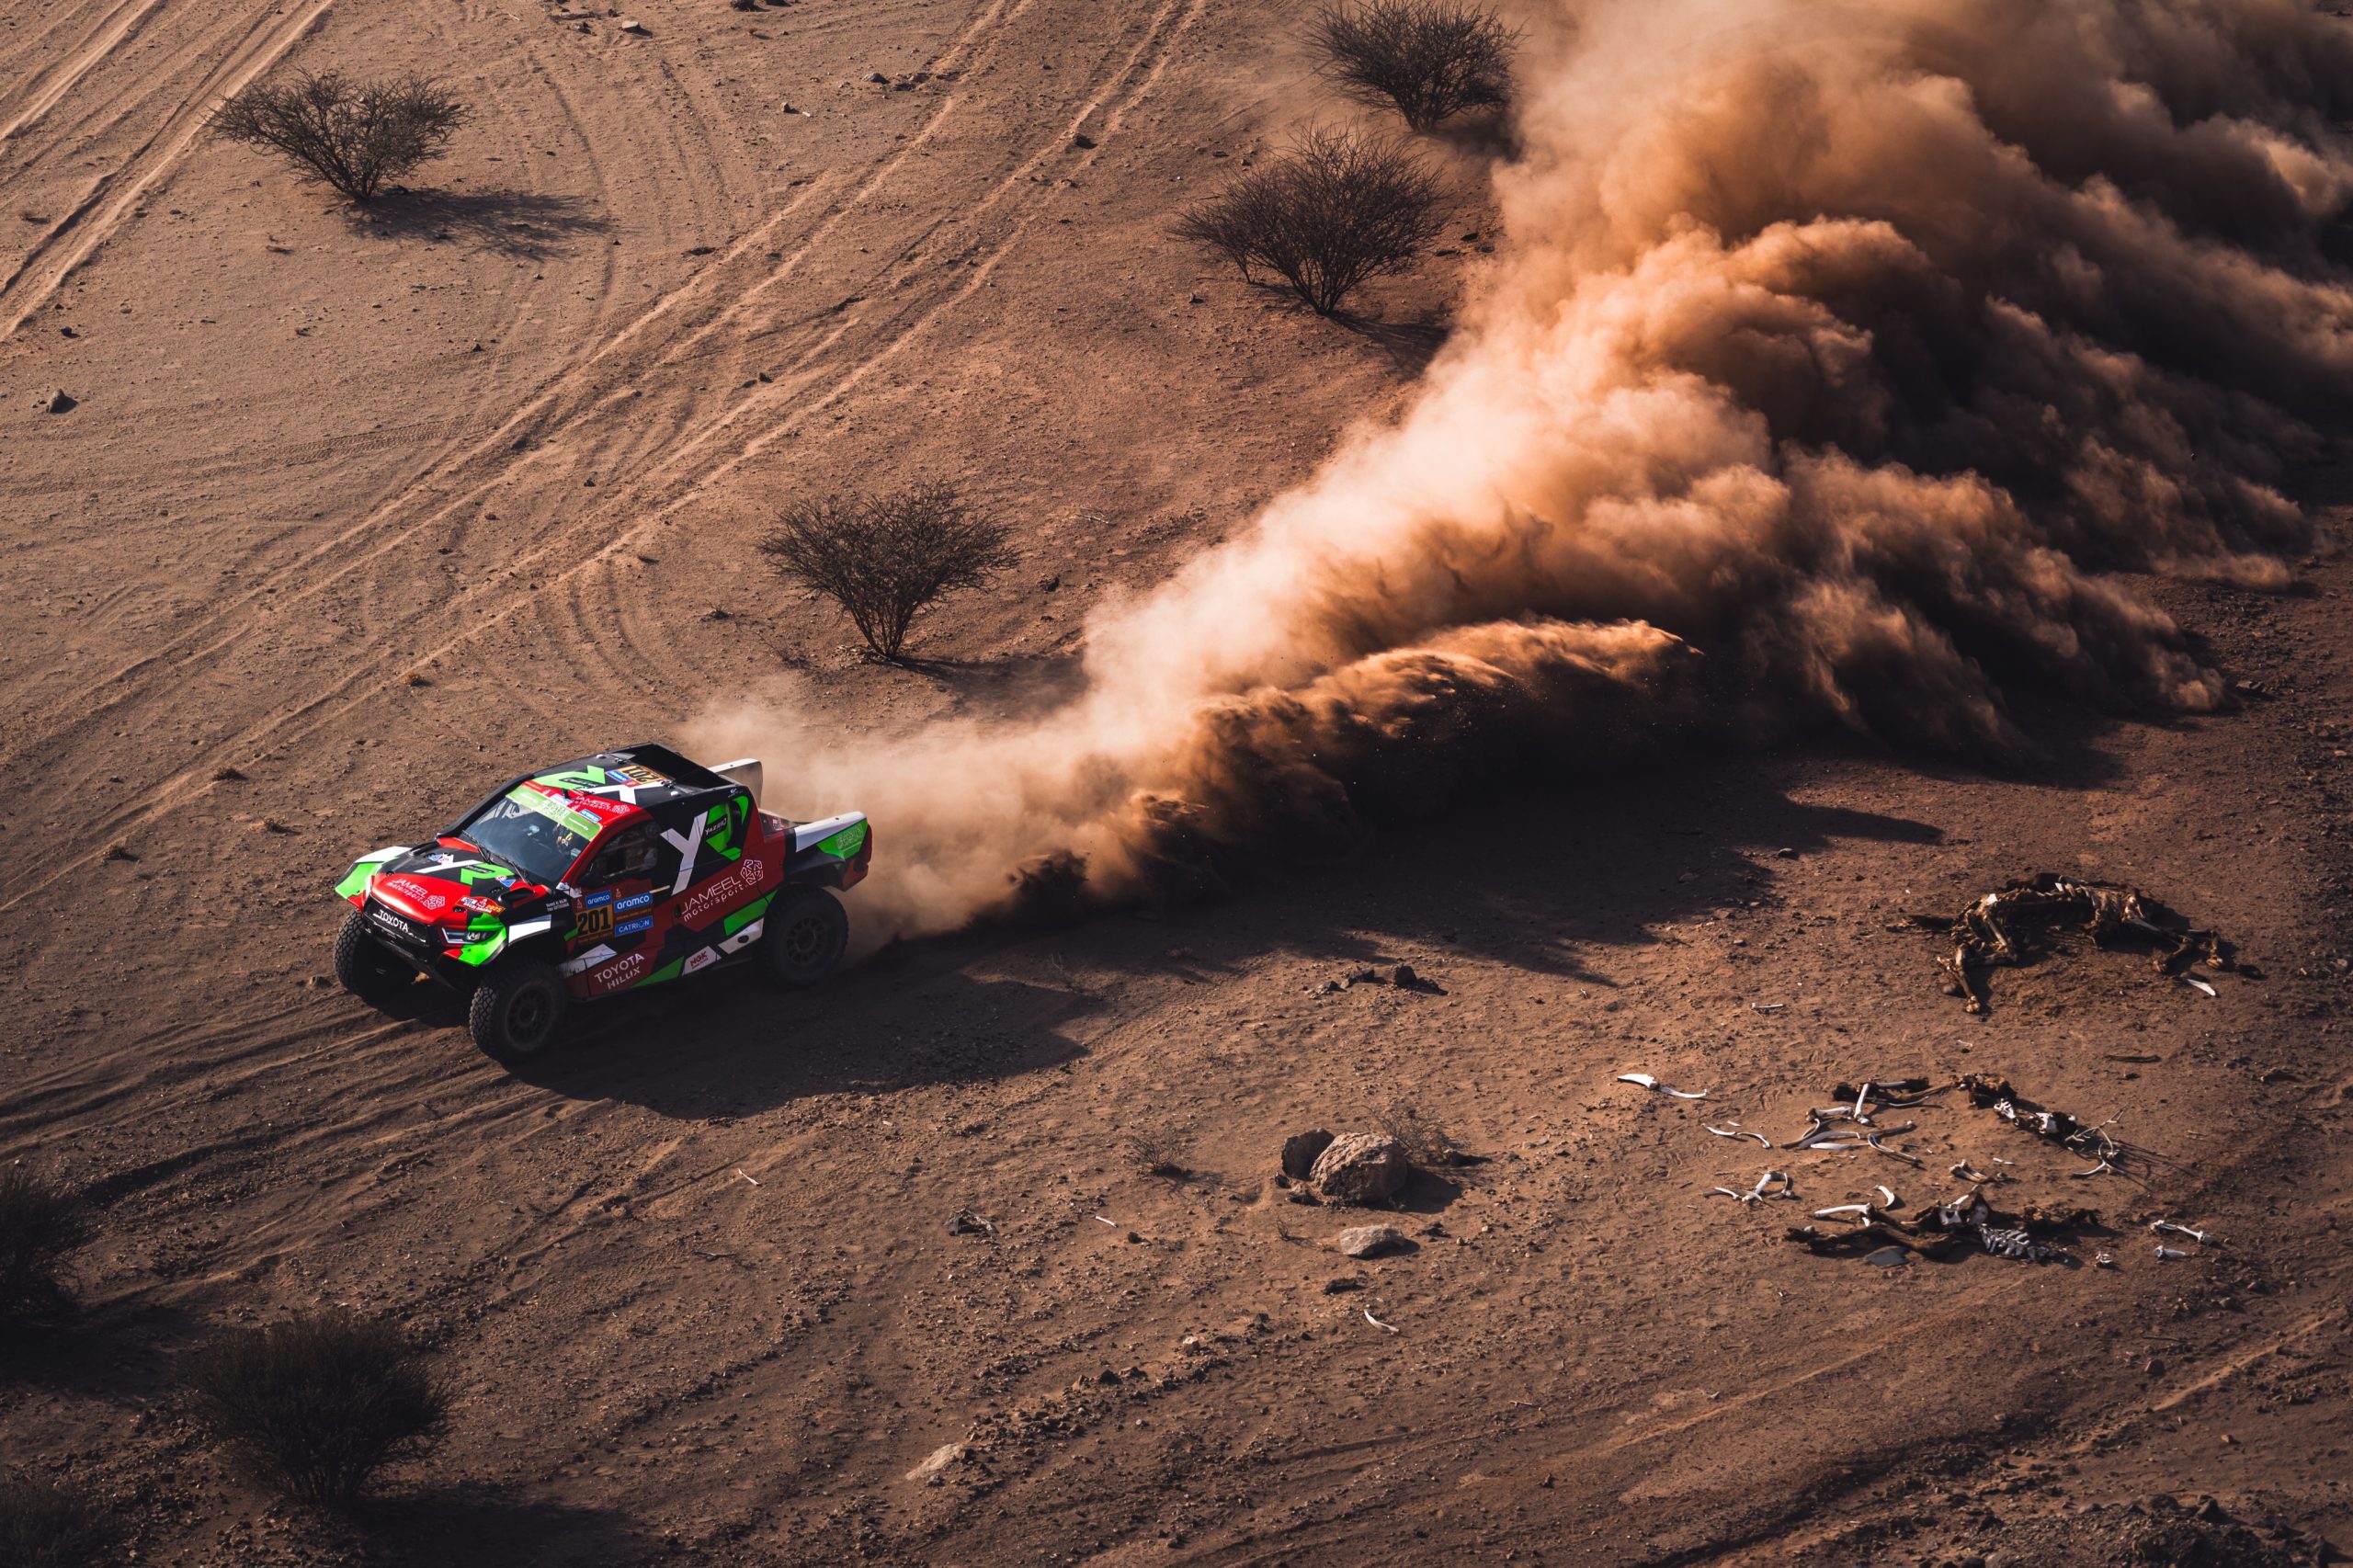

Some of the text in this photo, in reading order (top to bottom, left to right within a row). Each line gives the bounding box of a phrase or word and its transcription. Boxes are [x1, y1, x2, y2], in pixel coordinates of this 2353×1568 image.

[392, 878, 428, 897] JAMEEL
[587, 894, 610, 904] aramco
[681, 876, 741, 915] JAMEEL
[617, 895, 650, 910] aramco
[380, 910, 409, 933] TOYOTA
[577, 907, 611, 934] 201
[594, 952, 645, 983] TOYOTA
[689, 950, 708, 967] NGK
[607, 966, 641, 990] HILUX
